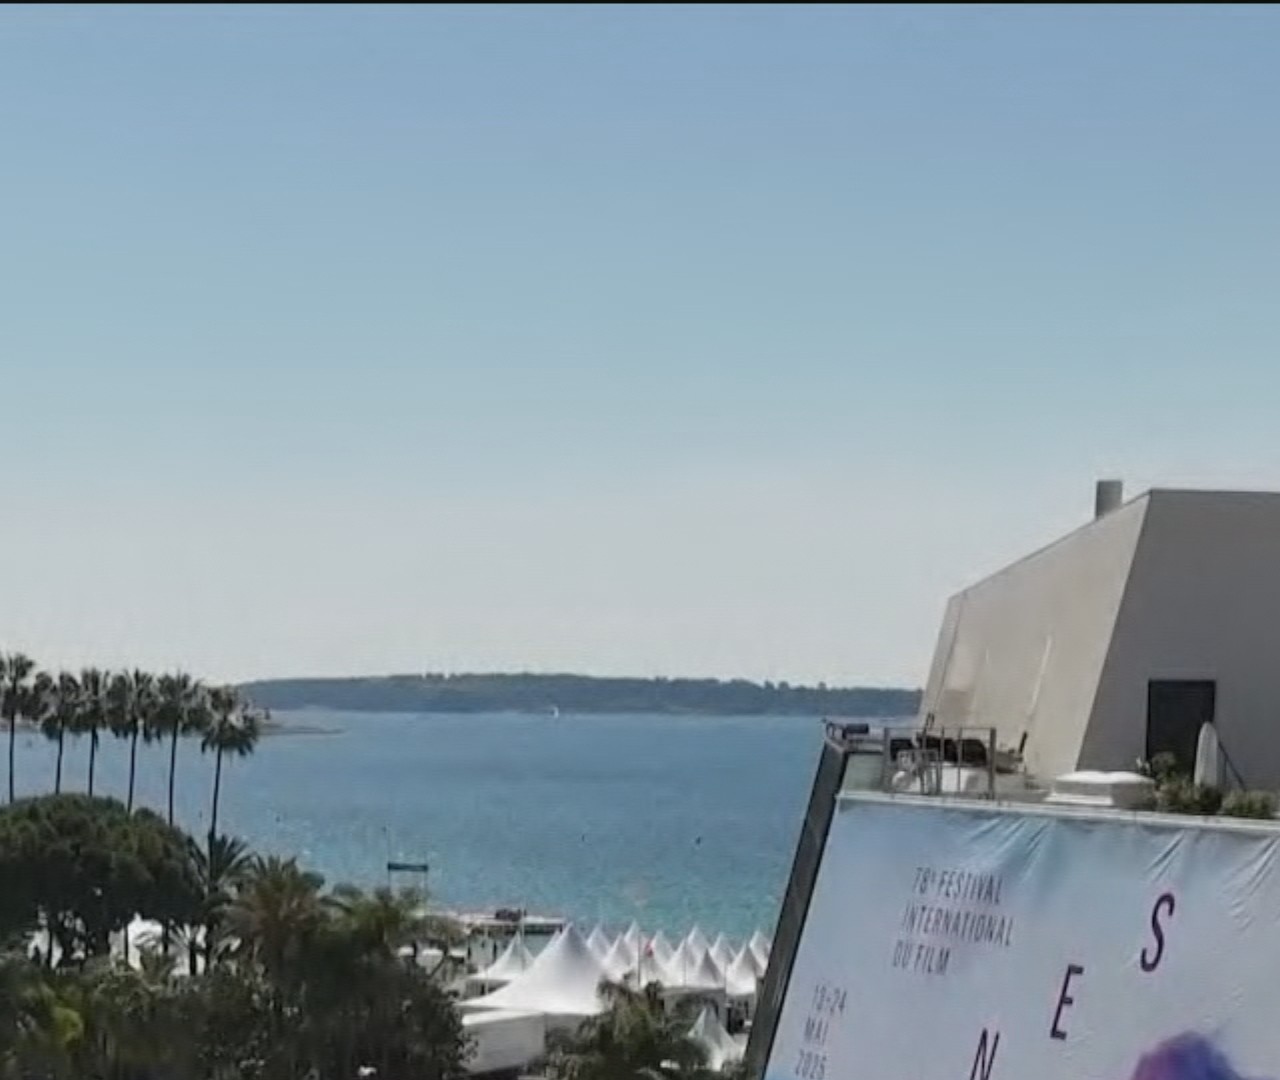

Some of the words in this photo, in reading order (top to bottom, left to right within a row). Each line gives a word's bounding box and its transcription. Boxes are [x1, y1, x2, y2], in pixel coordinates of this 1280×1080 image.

[939, 869, 1003, 904] FESTIVAL
[904, 902, 1013, 946] INTERNATIONAL
[893, 939, 913, 968] DU
[914, 944, 951, 976] FILM
[803, 1015, 829, 1047] MAI
